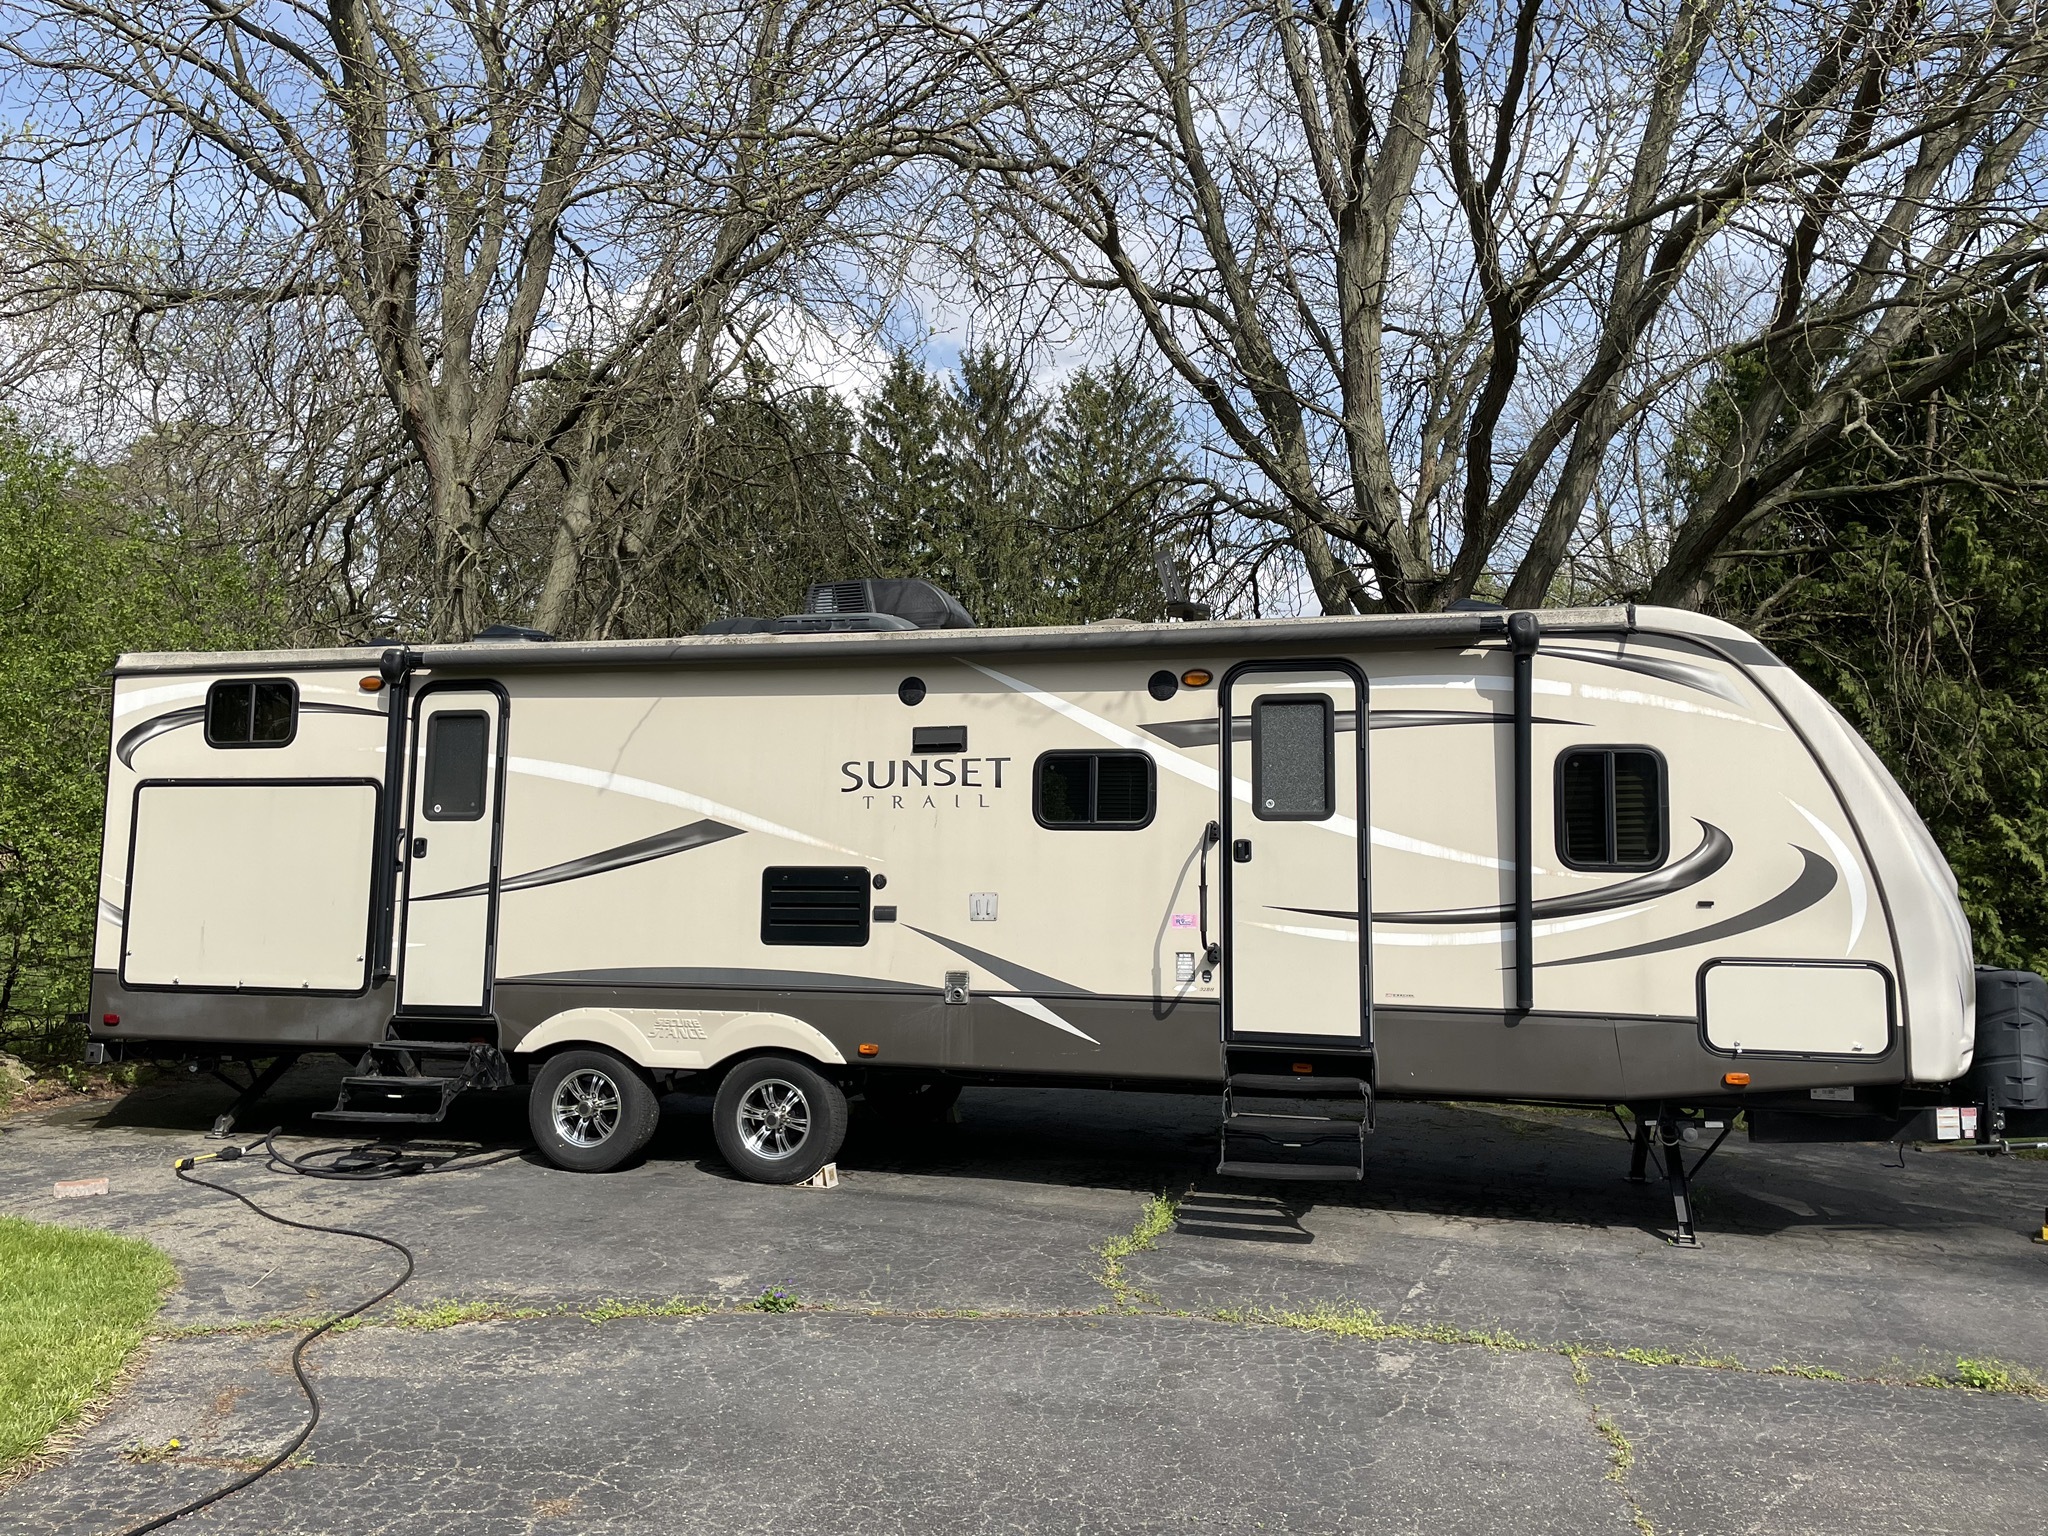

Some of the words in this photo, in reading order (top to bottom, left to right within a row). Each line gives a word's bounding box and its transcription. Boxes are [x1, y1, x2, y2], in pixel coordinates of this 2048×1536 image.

[841, 757, 1011, 793] SUNSET
[862, 794, 990, 810] TRAIL
[653, 1017, 702, 1028] SECURE
[647, 1027, 708, 1040] STANCE
